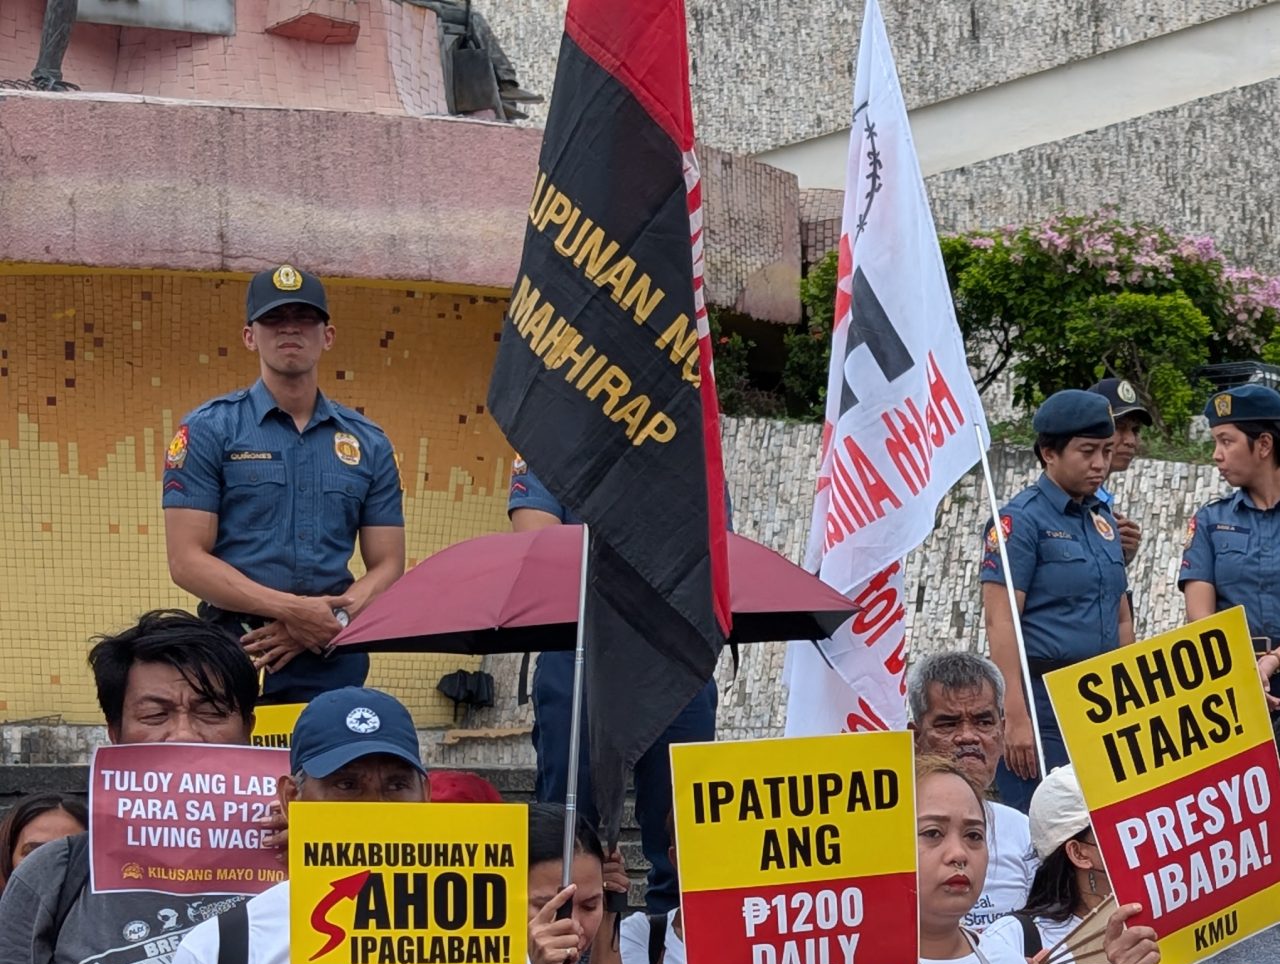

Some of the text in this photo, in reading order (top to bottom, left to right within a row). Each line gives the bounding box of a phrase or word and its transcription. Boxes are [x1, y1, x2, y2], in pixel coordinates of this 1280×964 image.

[1077, 628, 1233, 724] SAHOD
[1101, 688, 1244, 784] ITAAS!
[101, 770, 173, 792] TULOY
[179, 773, 225, 795] ANG
[692, 768, 899, 824] IPATUPAD
[117, 798, 178, 820] PARA
[185, 800, 216, 822] SA
[1115, 765, 1271, 870] PRESYO
[127, 826, 200, 848] LIVING
[304, 842, 514, 868] NAKABUBUHAY NA
[759, 824, 842, 871] ANG
[148, 867, 284, 882] KILUSANG MAYO UNO
[1143, 820, 1272, 920] IBABA!
[350, 935, 511, 964] IPAGLABAN!
[1194, 910, 1239, 952] KMU
